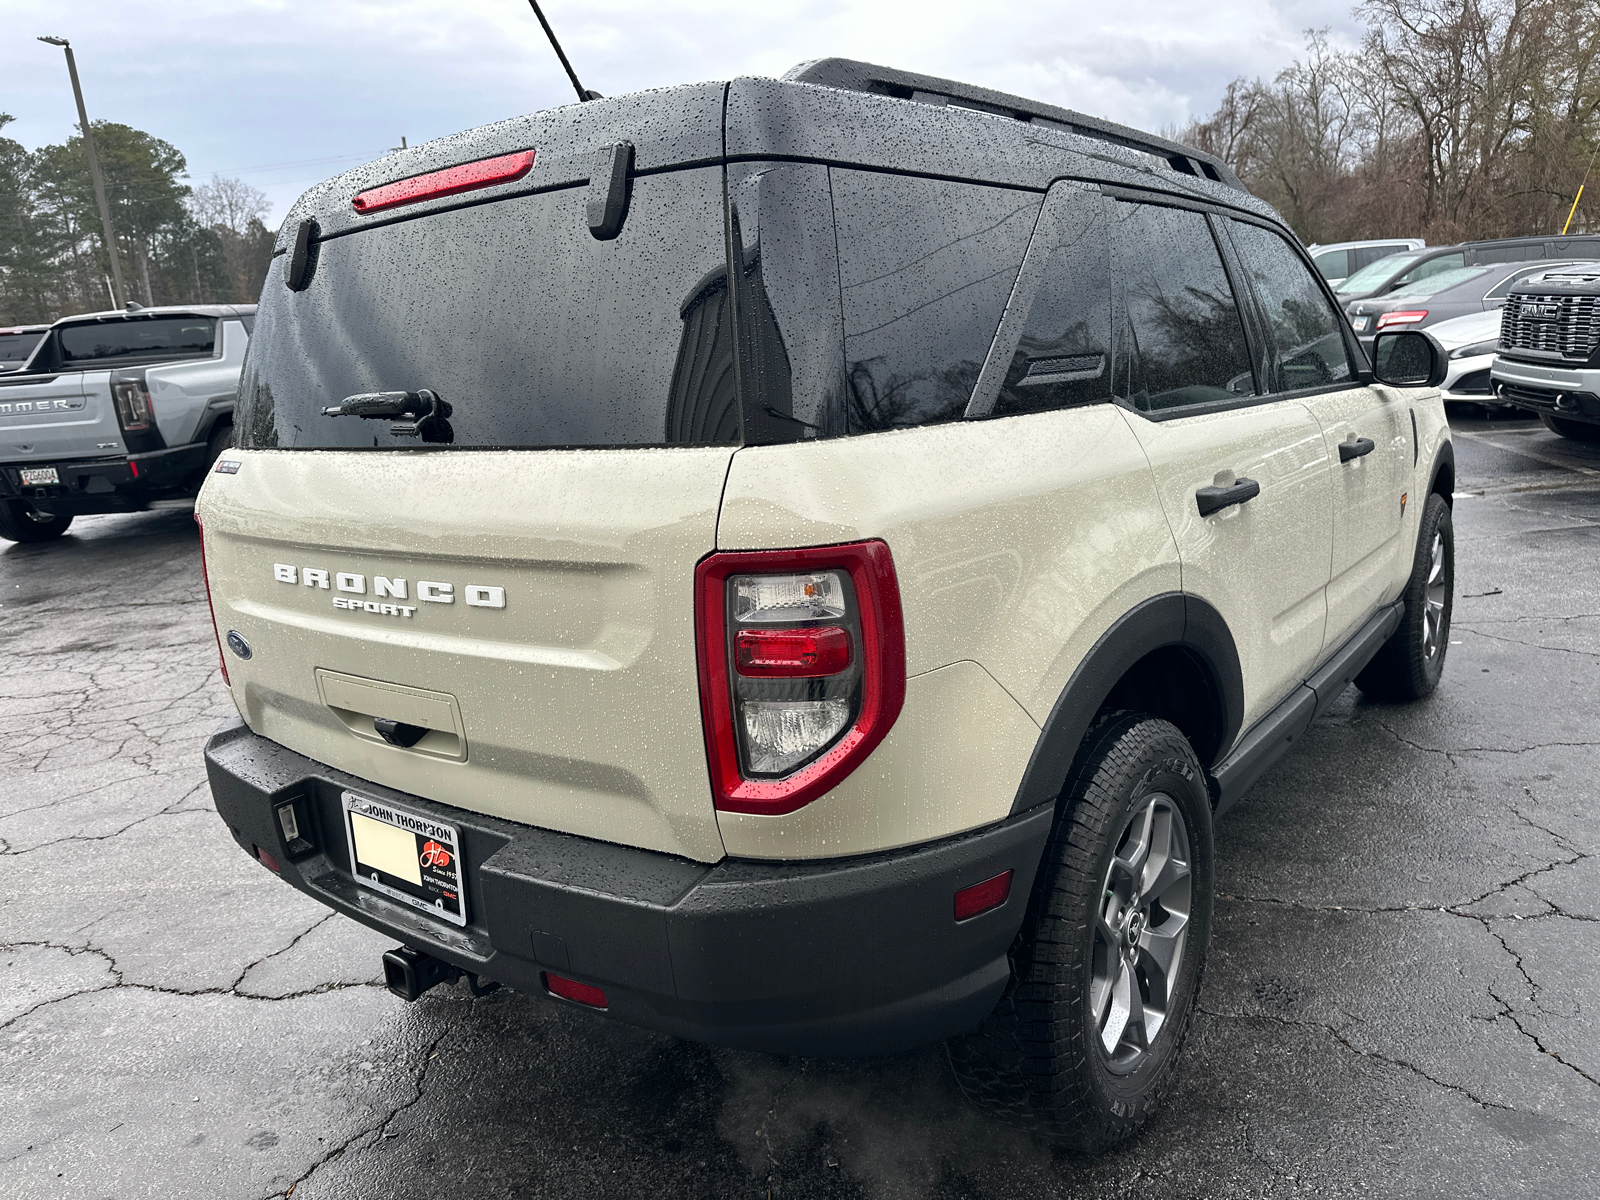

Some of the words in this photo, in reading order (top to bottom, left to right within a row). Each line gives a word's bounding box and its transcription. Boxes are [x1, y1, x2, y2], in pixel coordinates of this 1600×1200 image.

[1520, 304, 1557, 318] GMC
[273, 563, 506, 608] BRONCO
[332, 596, 417, 618] SPORT
[368, 804, 393, 822] JOHN
[395, 813, 452, 842] THORNTON
[432, 865, 446, 876] Since
[423, 874, 435, 884] JOHN
[442, 890, 457, 900] GMC
[411, 898, 428, 911] GMC
